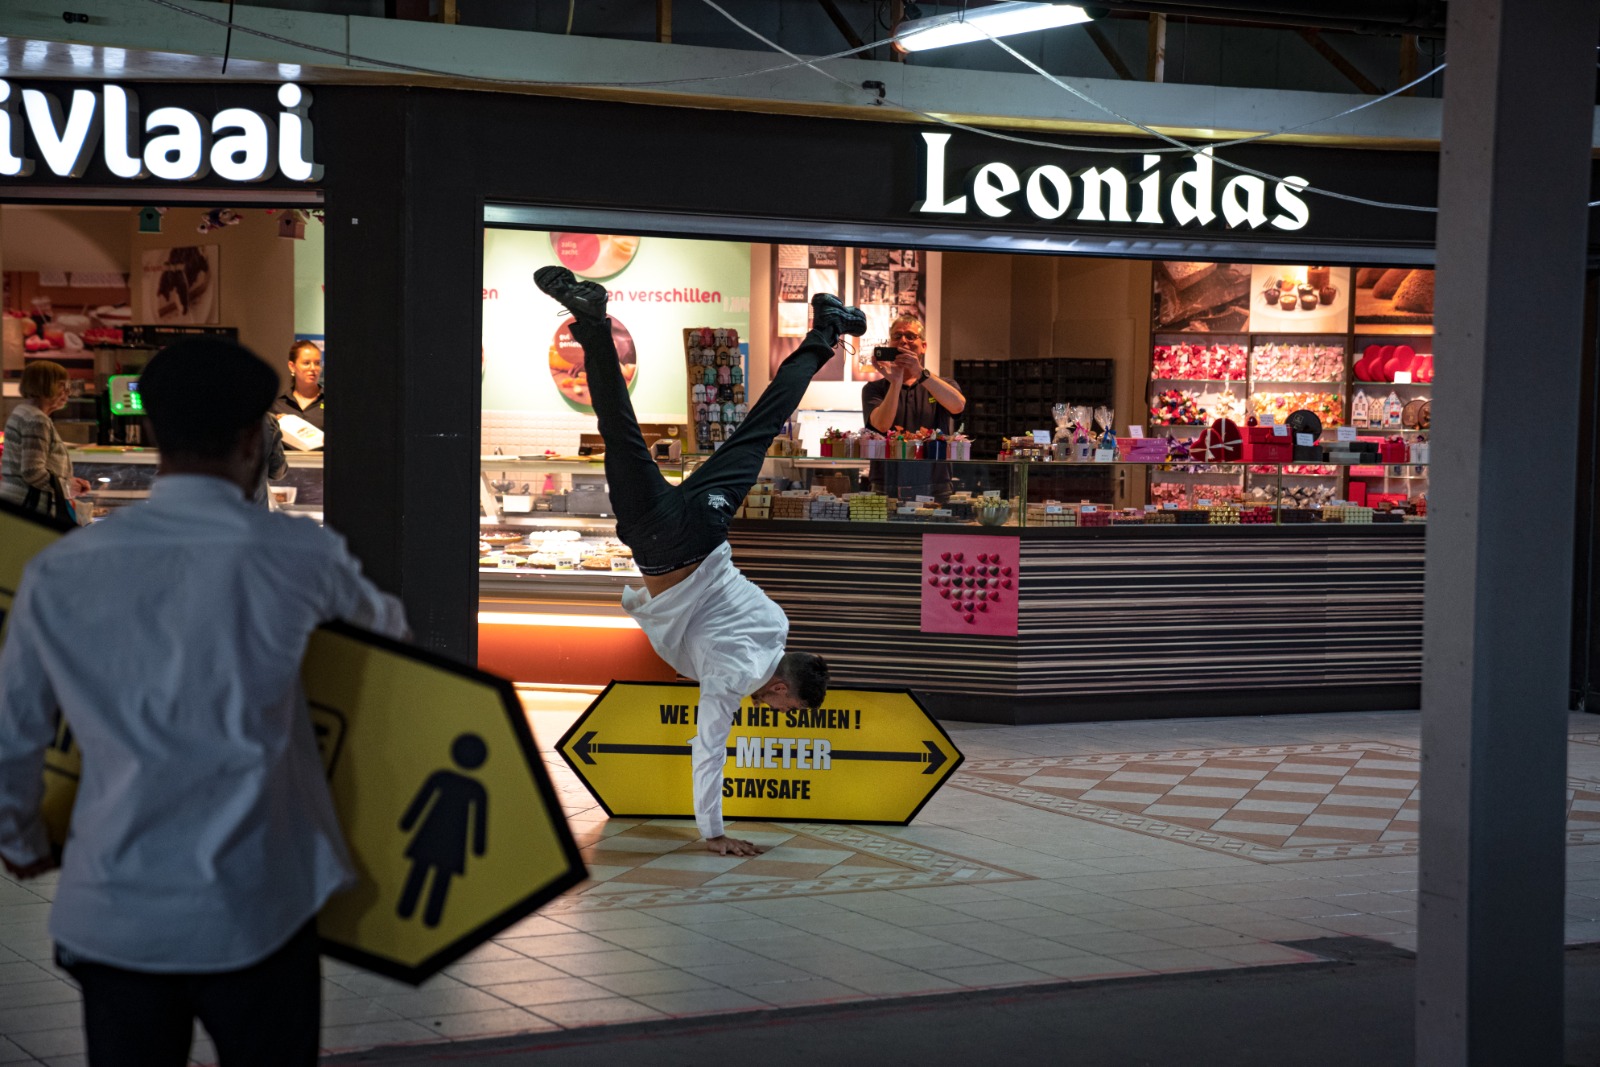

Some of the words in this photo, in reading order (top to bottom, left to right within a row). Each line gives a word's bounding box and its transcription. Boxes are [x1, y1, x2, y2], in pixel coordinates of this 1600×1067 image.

[920, 132, 1310, 230] Leonidas
[628, 287, 722, 303] verschillen
[660, 704, 689, 725] WE
[747, 706, 779, 727] HET
[786, 708, 850, 729] SAMEN
[736, 736, 832, 770] METER
[722, 777, 811, 800] STAYSAFE
